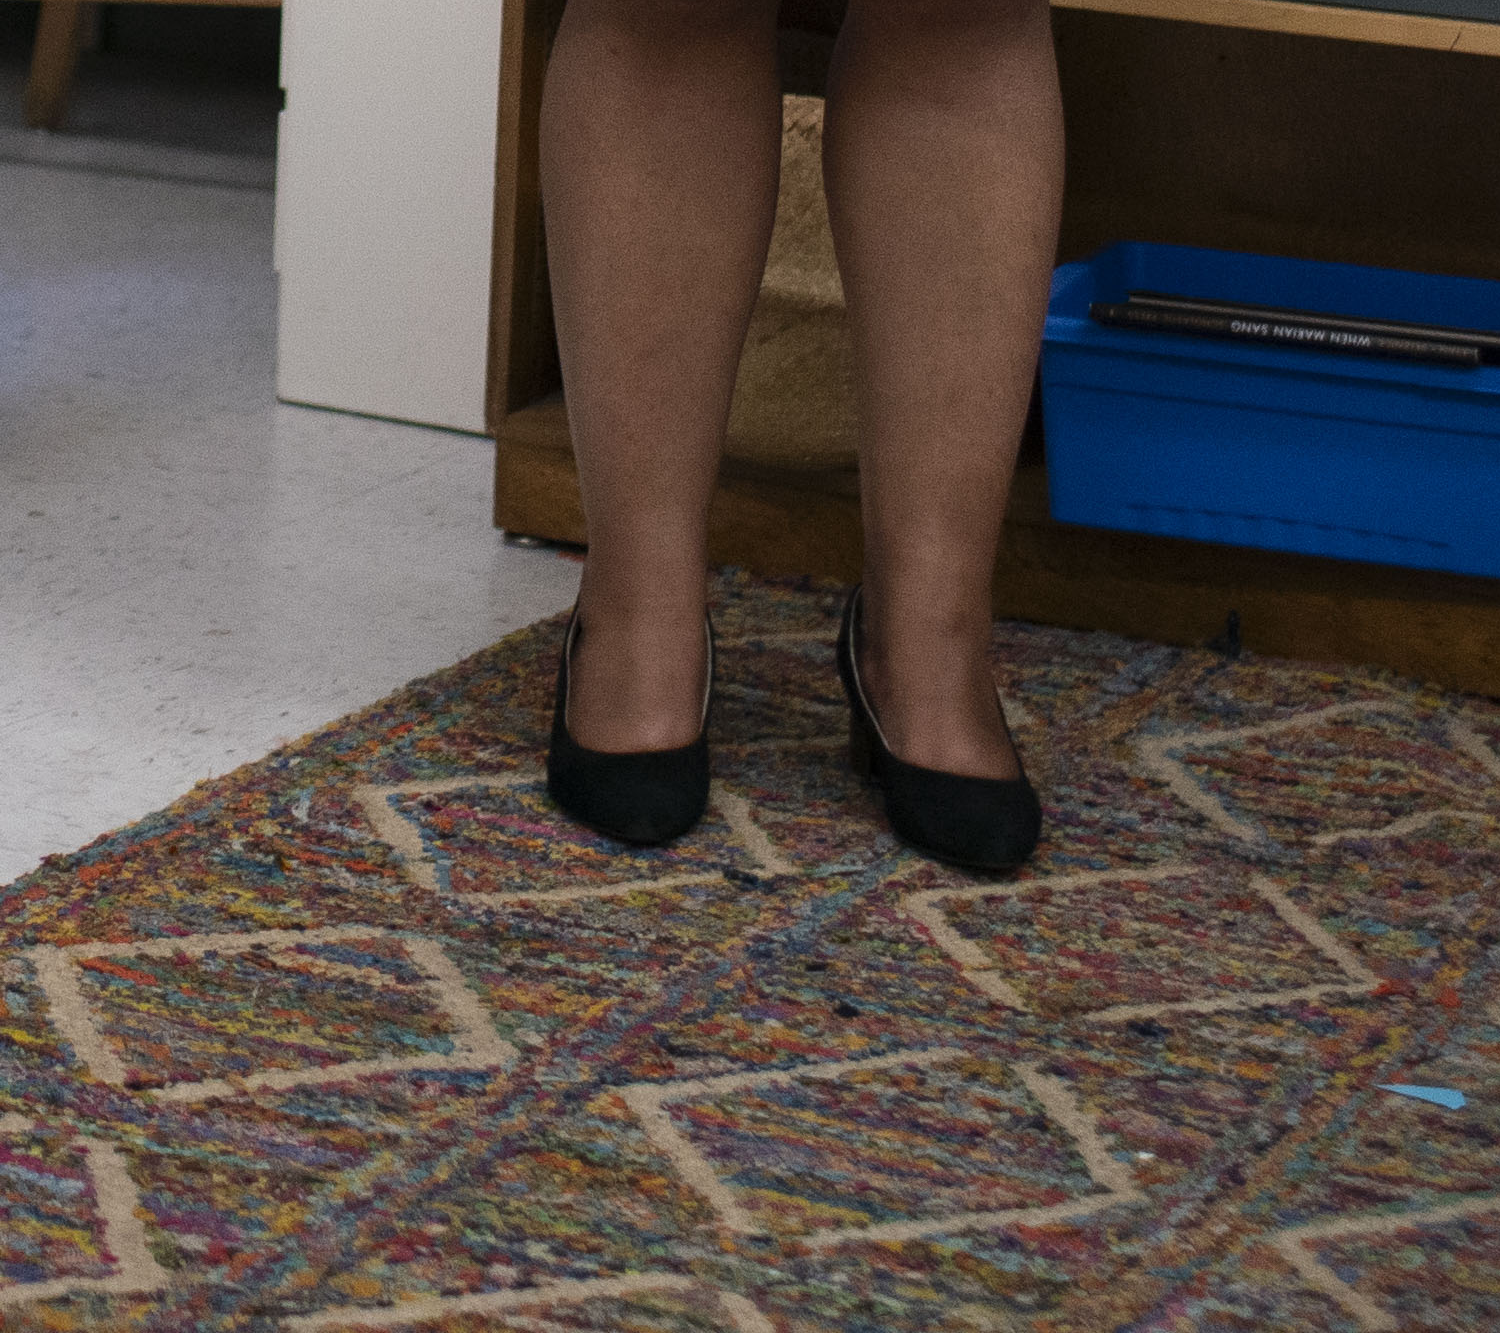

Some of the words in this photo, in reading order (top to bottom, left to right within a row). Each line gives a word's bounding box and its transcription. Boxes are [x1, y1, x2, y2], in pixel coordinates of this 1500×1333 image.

[1230, 319, 1269, 336] SANG
[1272, 324, 1326, 343] MARIAN
[1328, 329, 1372, 348] WHEN
